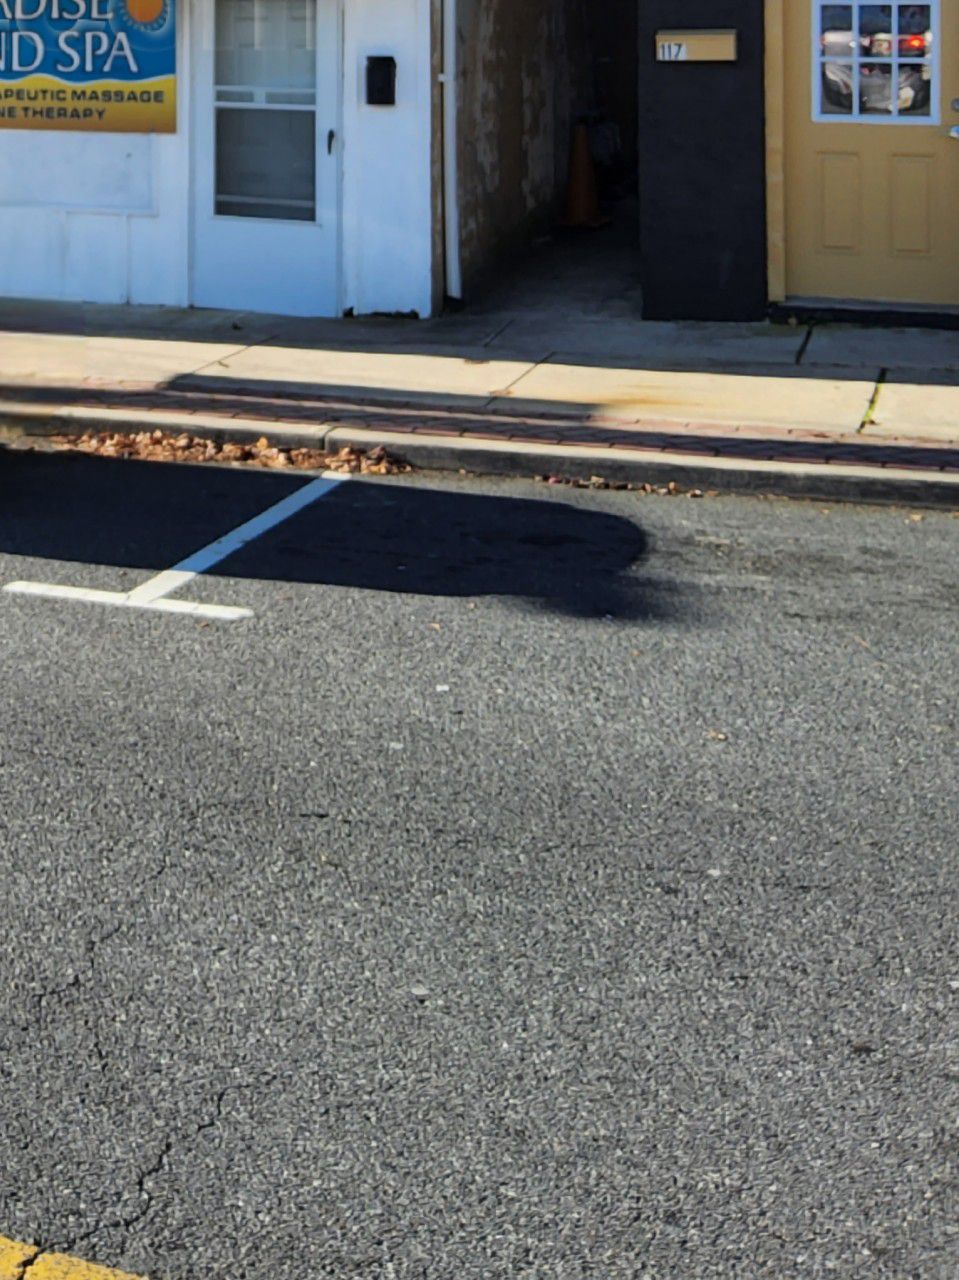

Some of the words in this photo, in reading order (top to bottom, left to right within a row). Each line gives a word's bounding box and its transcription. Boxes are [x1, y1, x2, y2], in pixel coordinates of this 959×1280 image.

[56, 30, 140, 73] SPA
[661, 43, 683, 60] 117
[71, 90, 165, 104] MASSAGE
[22, 106, 107, 121] THERAPY
